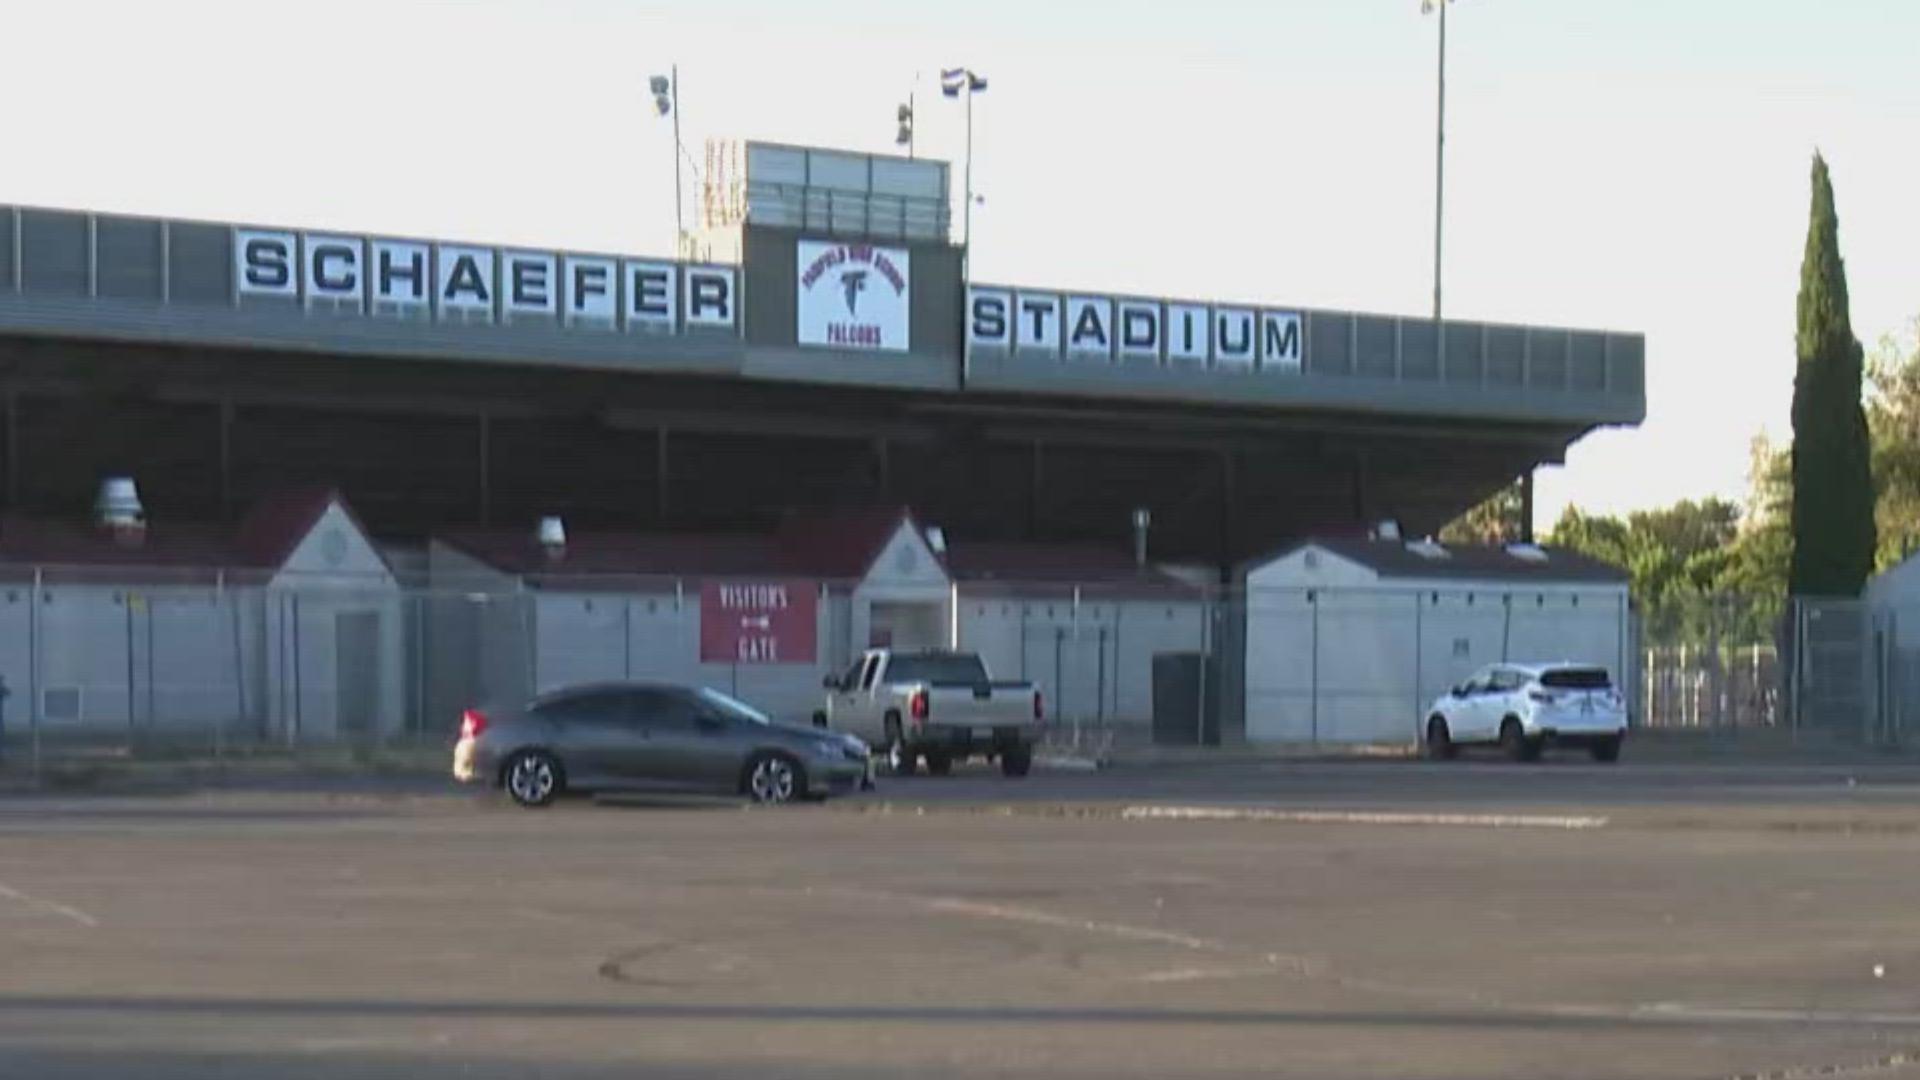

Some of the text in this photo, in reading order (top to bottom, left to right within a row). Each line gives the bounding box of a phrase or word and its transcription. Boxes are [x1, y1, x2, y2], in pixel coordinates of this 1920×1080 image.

[245, 237, 729, 318] SCHAEFER
[972, 296, 1299, 359] STADIUM
[738, 636, 778, 662] GATE
